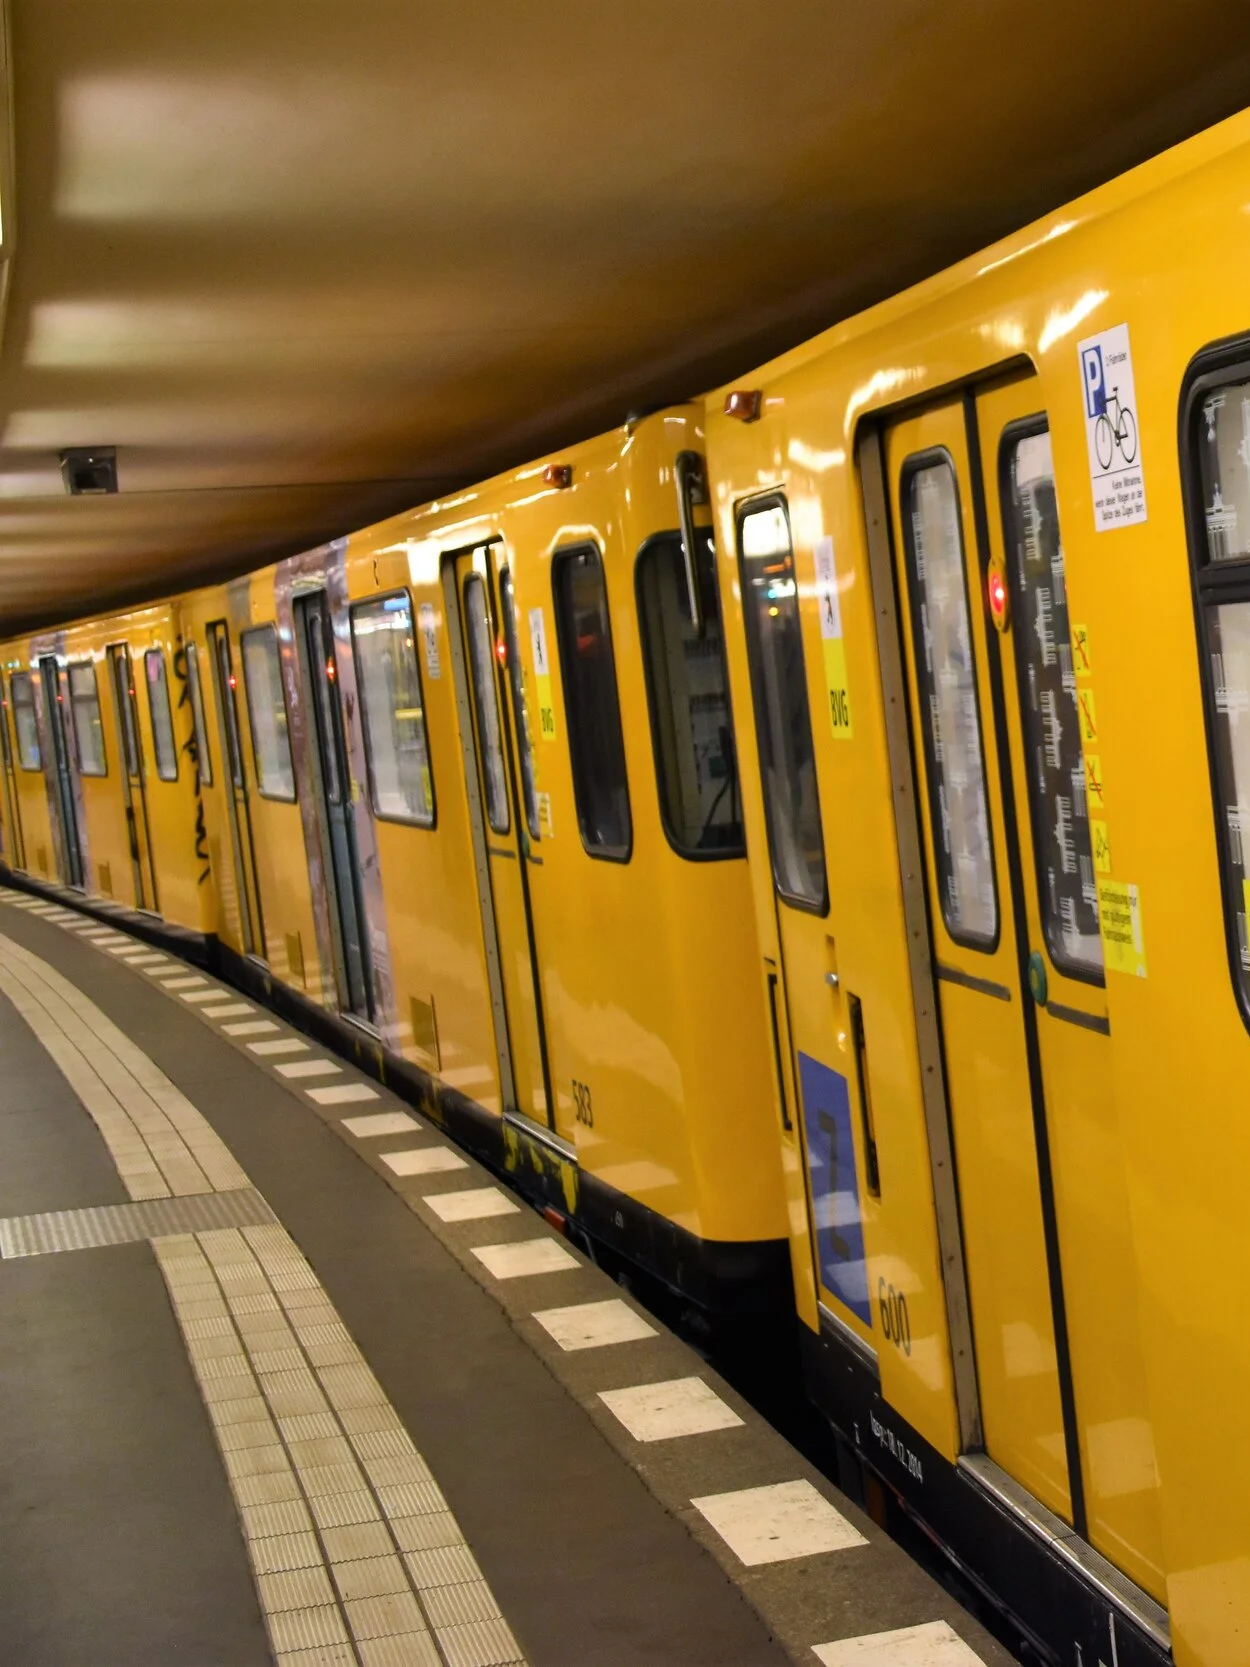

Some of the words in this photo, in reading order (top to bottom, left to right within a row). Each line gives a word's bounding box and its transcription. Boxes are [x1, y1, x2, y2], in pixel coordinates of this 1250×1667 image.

[1084, 349, 1102, 416] P
[830, 689, 848, 727] BVG
[572, 1079, 593, 1129] 583
[879, 1275, 911, 1357] 600
